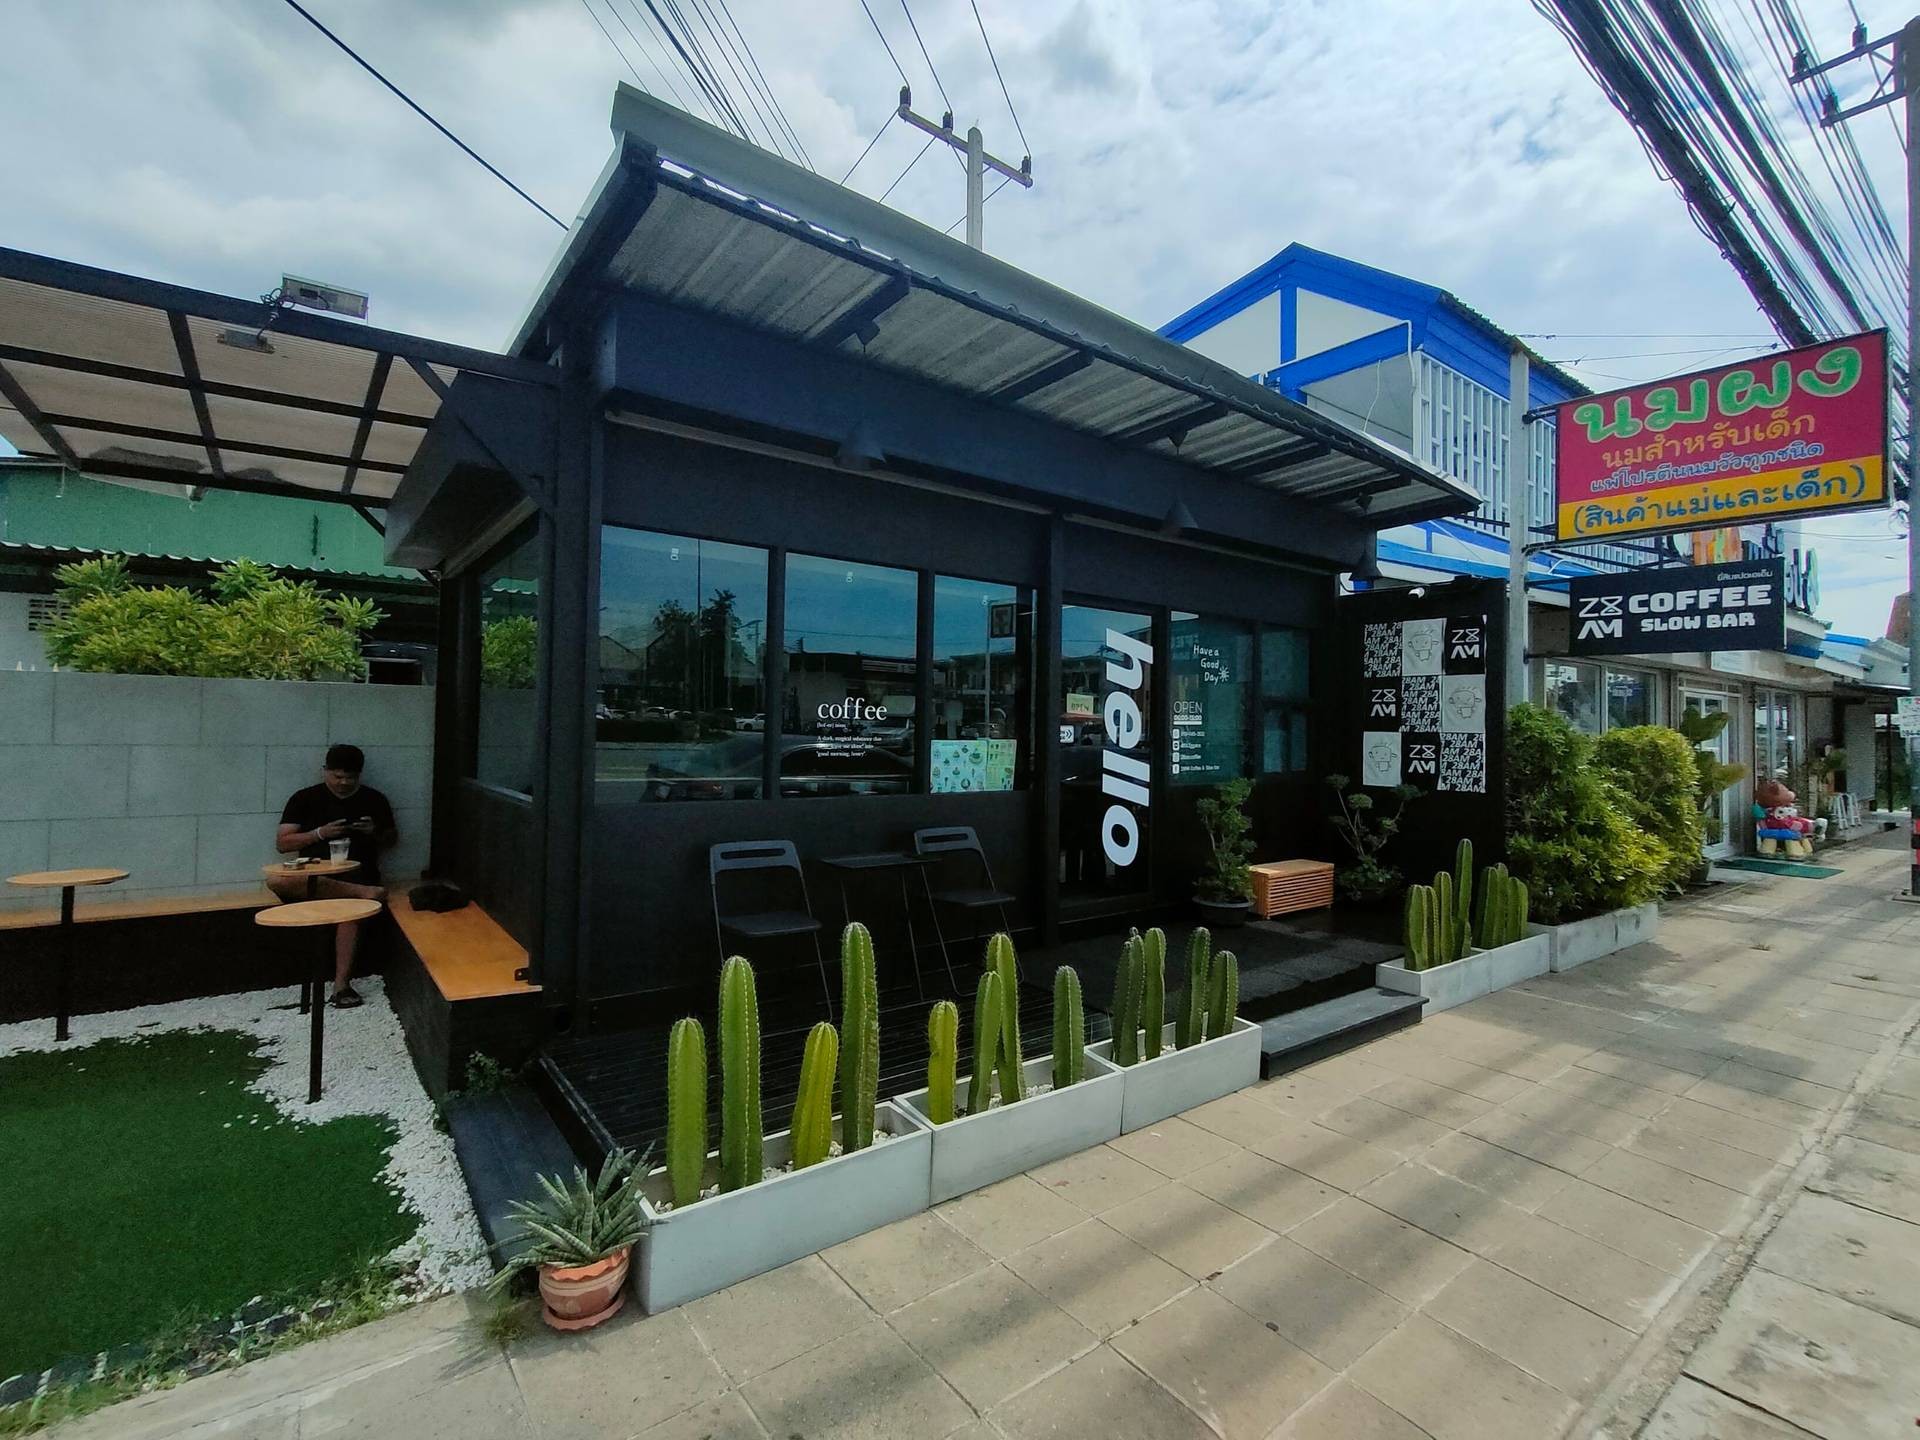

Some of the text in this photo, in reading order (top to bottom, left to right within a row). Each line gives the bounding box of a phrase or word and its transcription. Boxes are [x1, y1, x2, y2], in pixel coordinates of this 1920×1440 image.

[1573, 346, 1862, 443] นมผง
[1602, 406, 1815, 469] นมสำหรับเด็ก
[1573, 464, 1865, 534] (สินค้าแม่และเด็ก)
[1628, 584, 1772, 614] COFFEE
[1641, 615, 1700, 633] SLOW
[1706, 612, 1755, 629] BAR
[1193, 644, 1213, 656] Have
[1200, 658, 1220, 668] Good
[1204, 672, 1218, 686] Day
[817, 696, 888, 720] coffee
[1174, 701, 1202, 714] OPEN
[1101, 628, 1154, 867] hello
